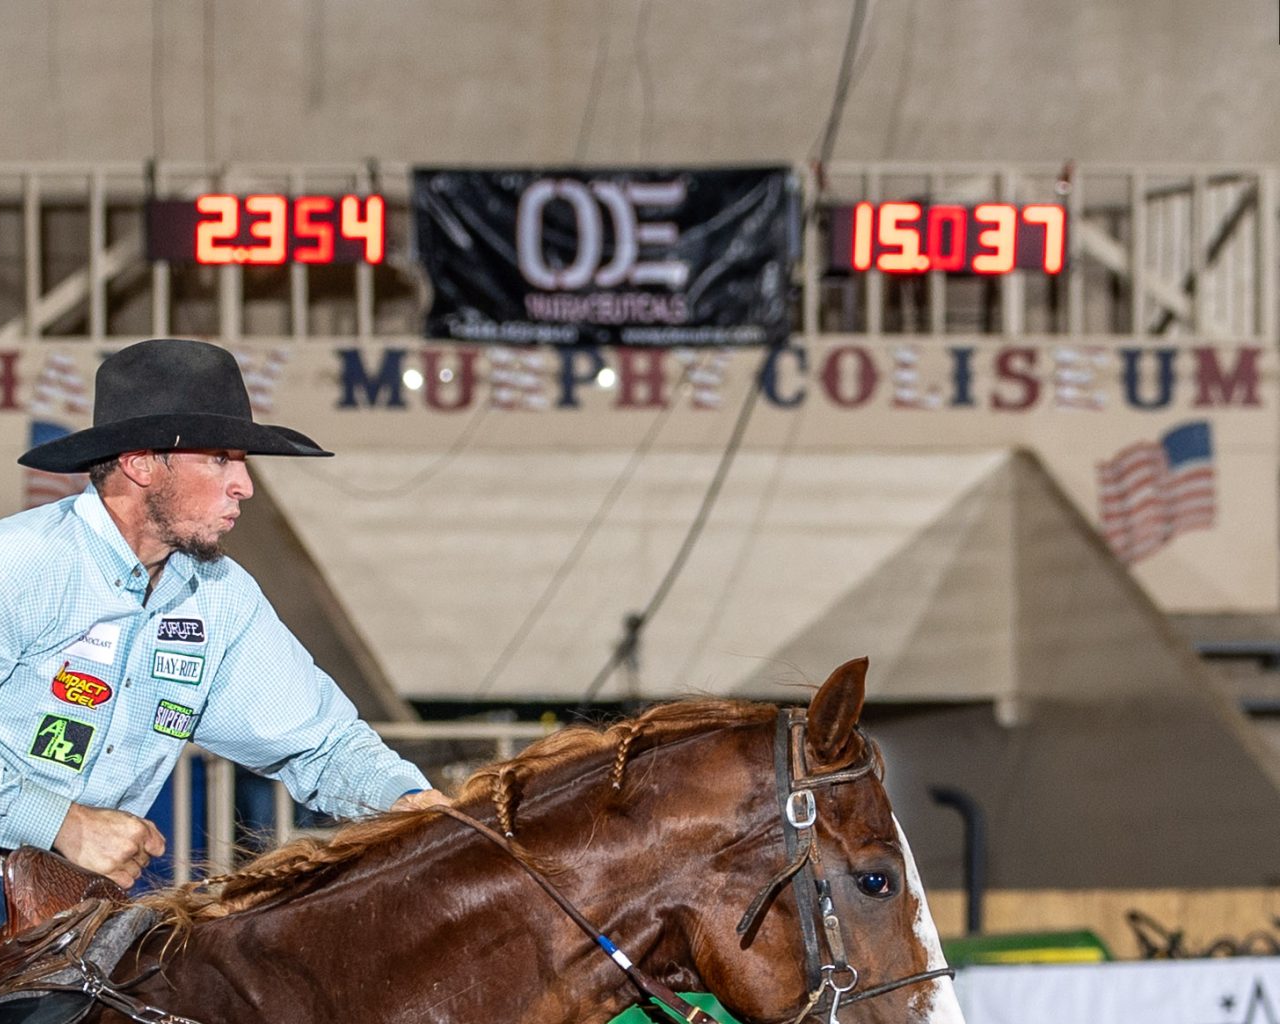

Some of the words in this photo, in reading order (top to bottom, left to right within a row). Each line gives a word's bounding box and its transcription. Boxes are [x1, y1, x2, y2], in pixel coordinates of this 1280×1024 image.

[337, 348, 730, 411] MURPHY
[760, 346, 1263, 410] COLISEUM
[156, 656, 200, 678] HAY-RITE
